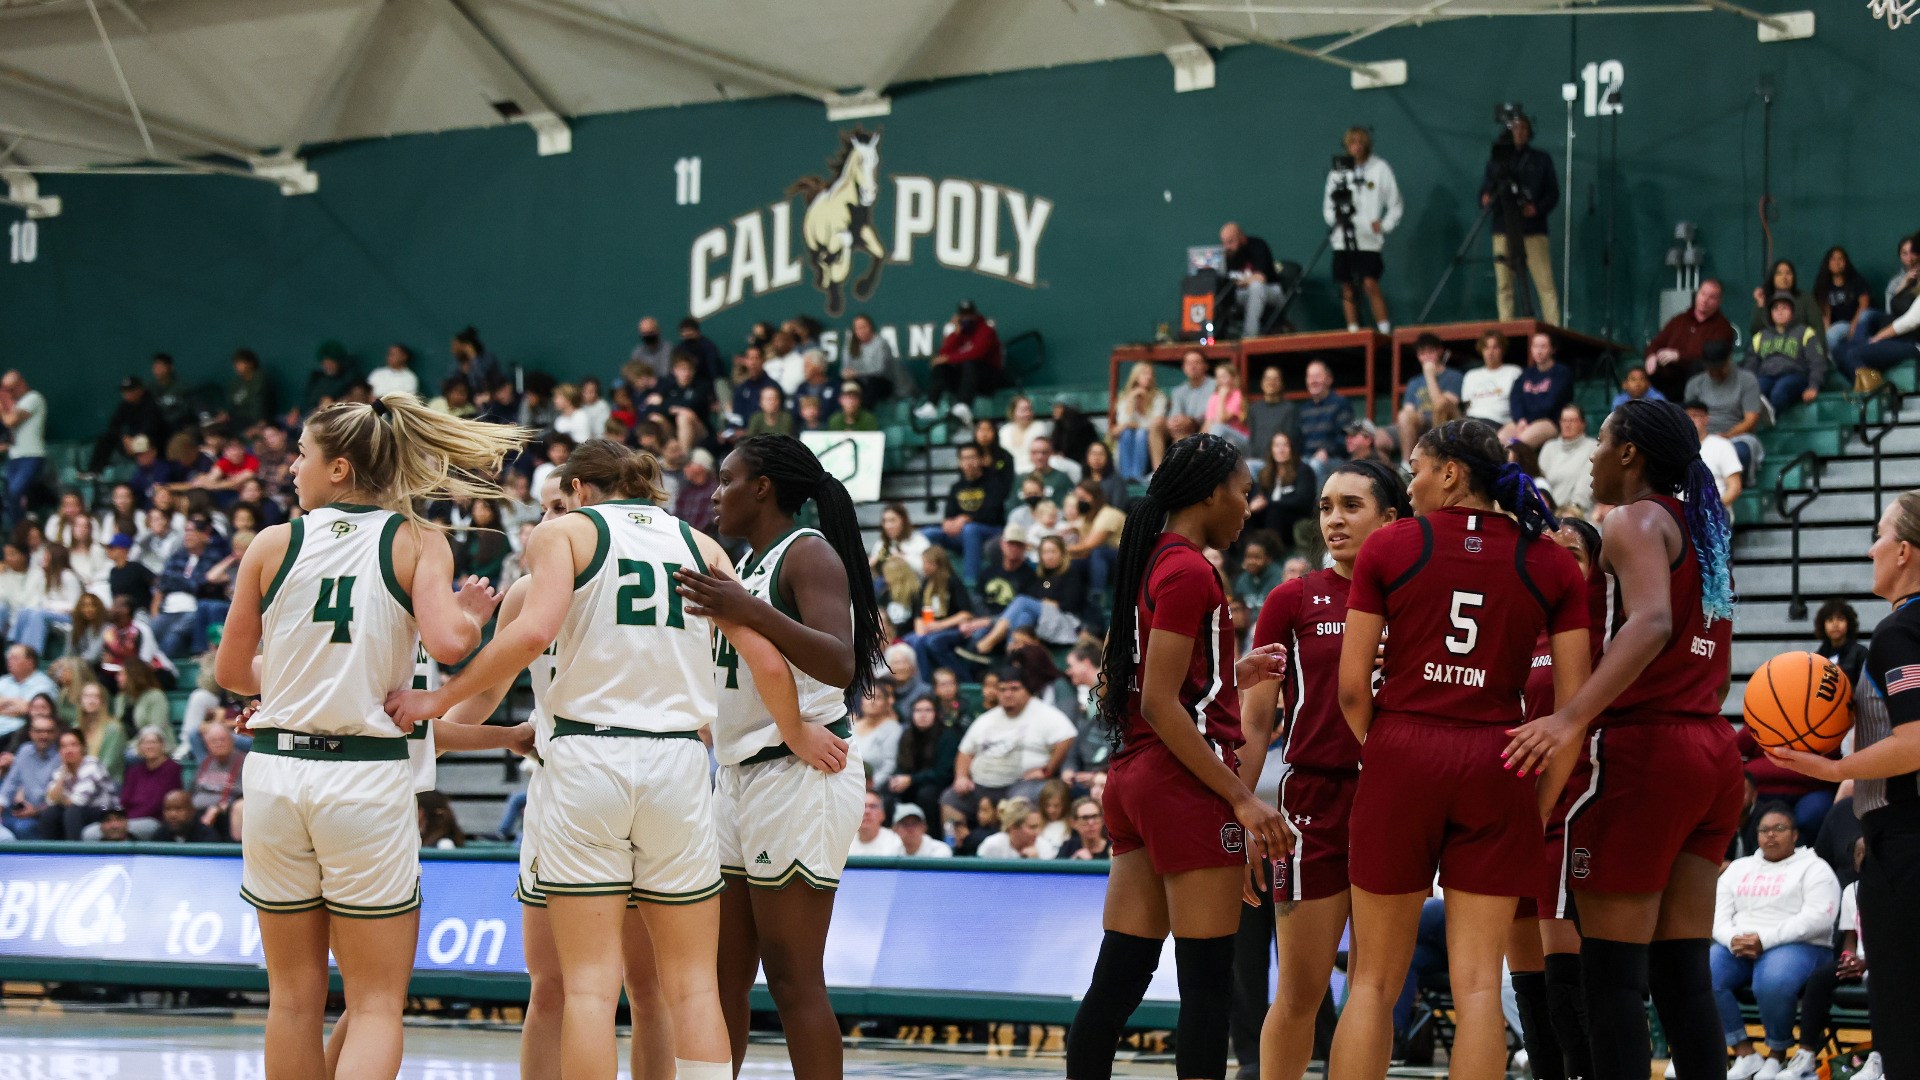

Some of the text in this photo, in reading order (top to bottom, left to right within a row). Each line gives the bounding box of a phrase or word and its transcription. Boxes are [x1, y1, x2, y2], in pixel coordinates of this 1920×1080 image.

[1581, 60, 1624, 117] 12
[674, 156, 701, 204] 11
[9, 221, 38, 263] 10
[689, 176, 1053, 319] CAL POLY
[312, 575, 357, 643] 4
[616, 558, 686, 630] 21
[1445, 590, 1484, 655] 5
[712, 625, 739, 690] 4
[1316, 621, 1346, 636] SOUT
[1423, 662, 1486, 688] SAXTON
[1530, 654, 1552, 668] AROL
[1816, 662, 1839, 702] Wil
[0, 879, 72, 941] BY
[165, 899, 223, 956] to
[426, 917, 507, 966] on
